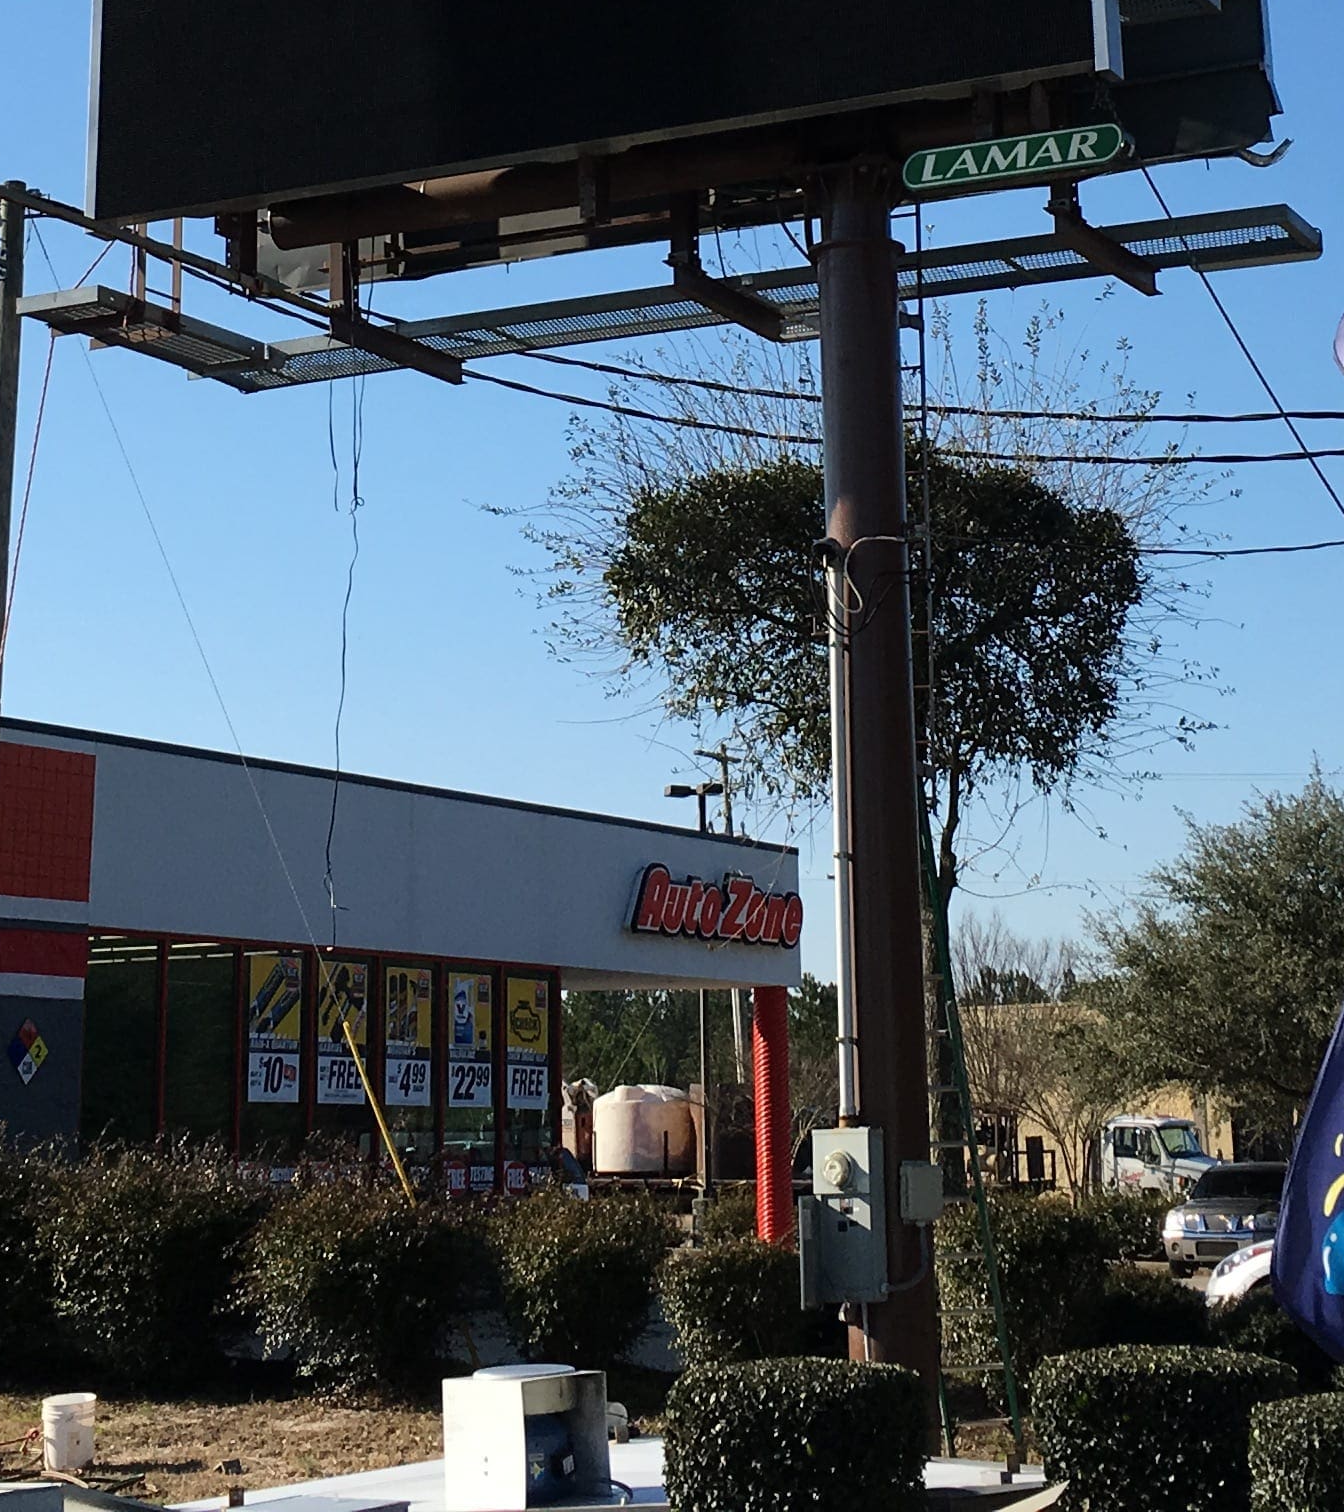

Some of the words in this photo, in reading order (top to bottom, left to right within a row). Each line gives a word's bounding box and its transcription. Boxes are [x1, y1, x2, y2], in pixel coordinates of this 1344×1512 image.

[920, 130, 1098, 182] LAMAR
[636, 866, 803, 947] AutoZone
[511, 1068, 544, 1097] FREE
